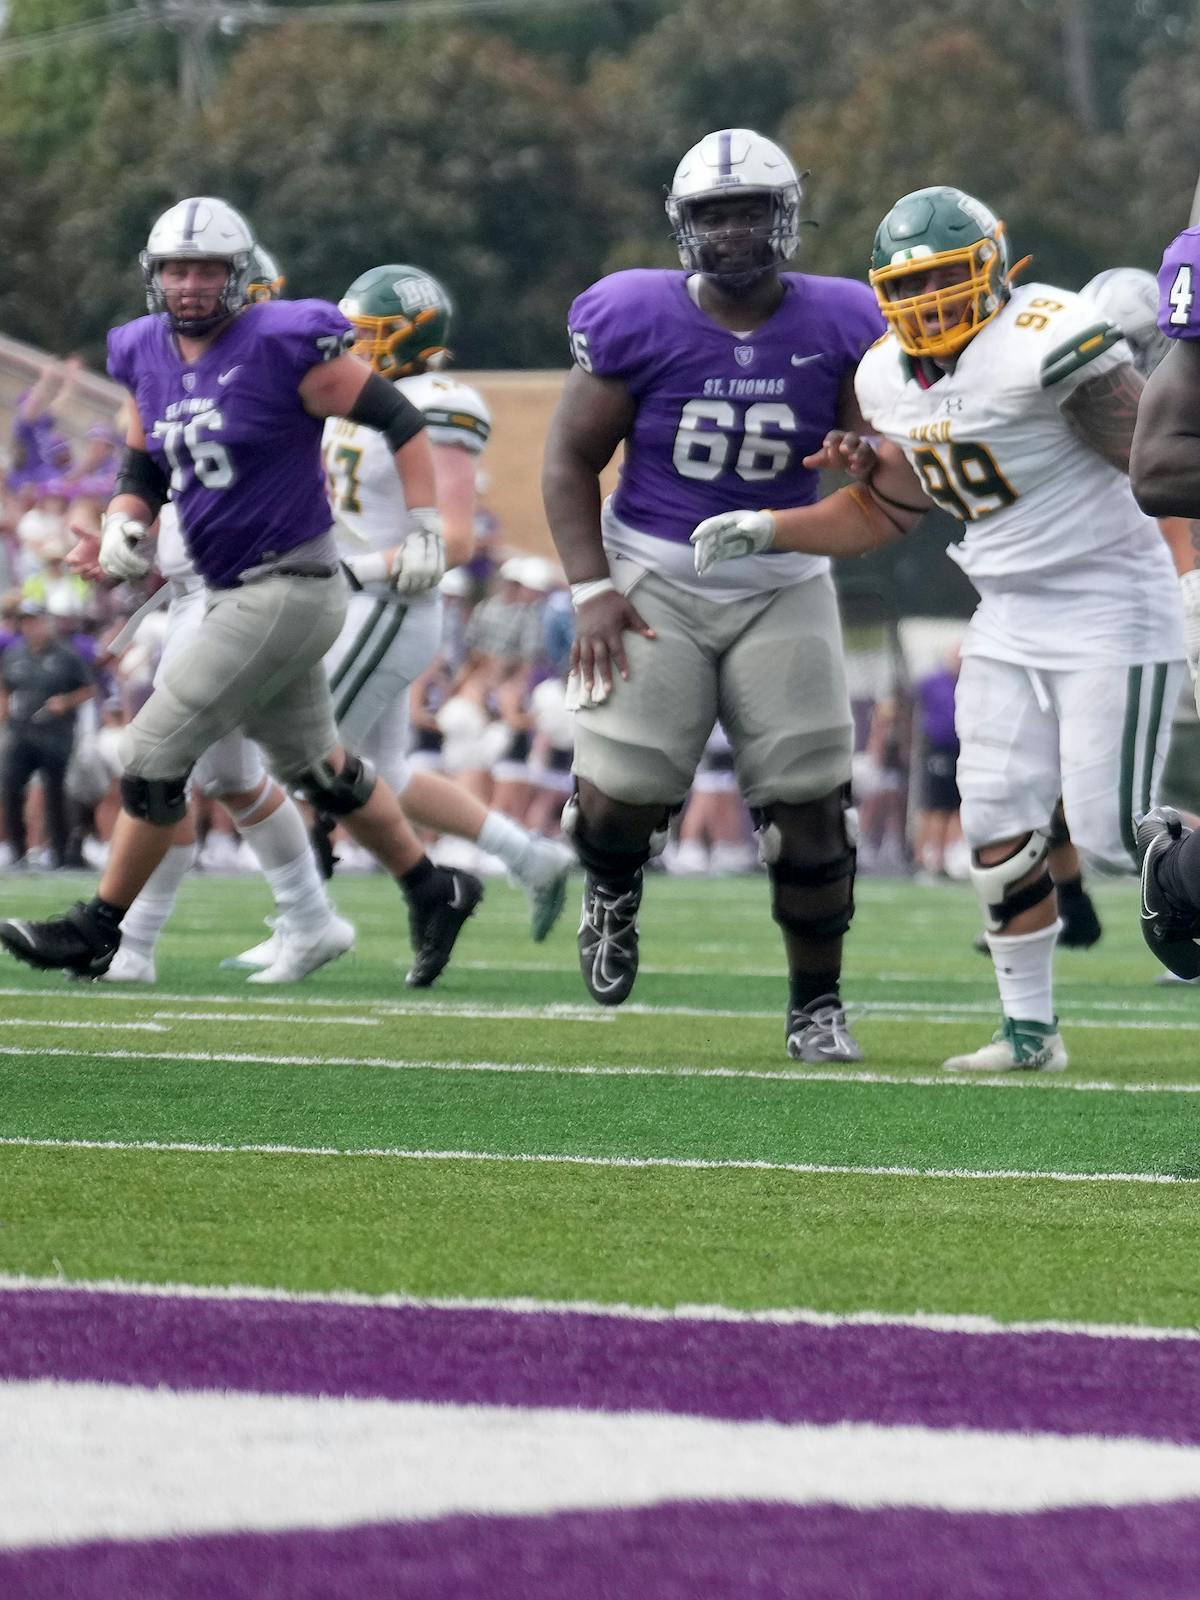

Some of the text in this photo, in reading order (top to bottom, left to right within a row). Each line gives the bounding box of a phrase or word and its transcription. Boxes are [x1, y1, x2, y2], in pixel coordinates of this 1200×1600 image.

[1169, 265, 1192, 324] 4
[566, 324, 593, 374] 6
[703, 377, 785, 396] ST. THOMAS
[672, 399, 797, 482] 66
[911, 442, 1021, 521] 99
